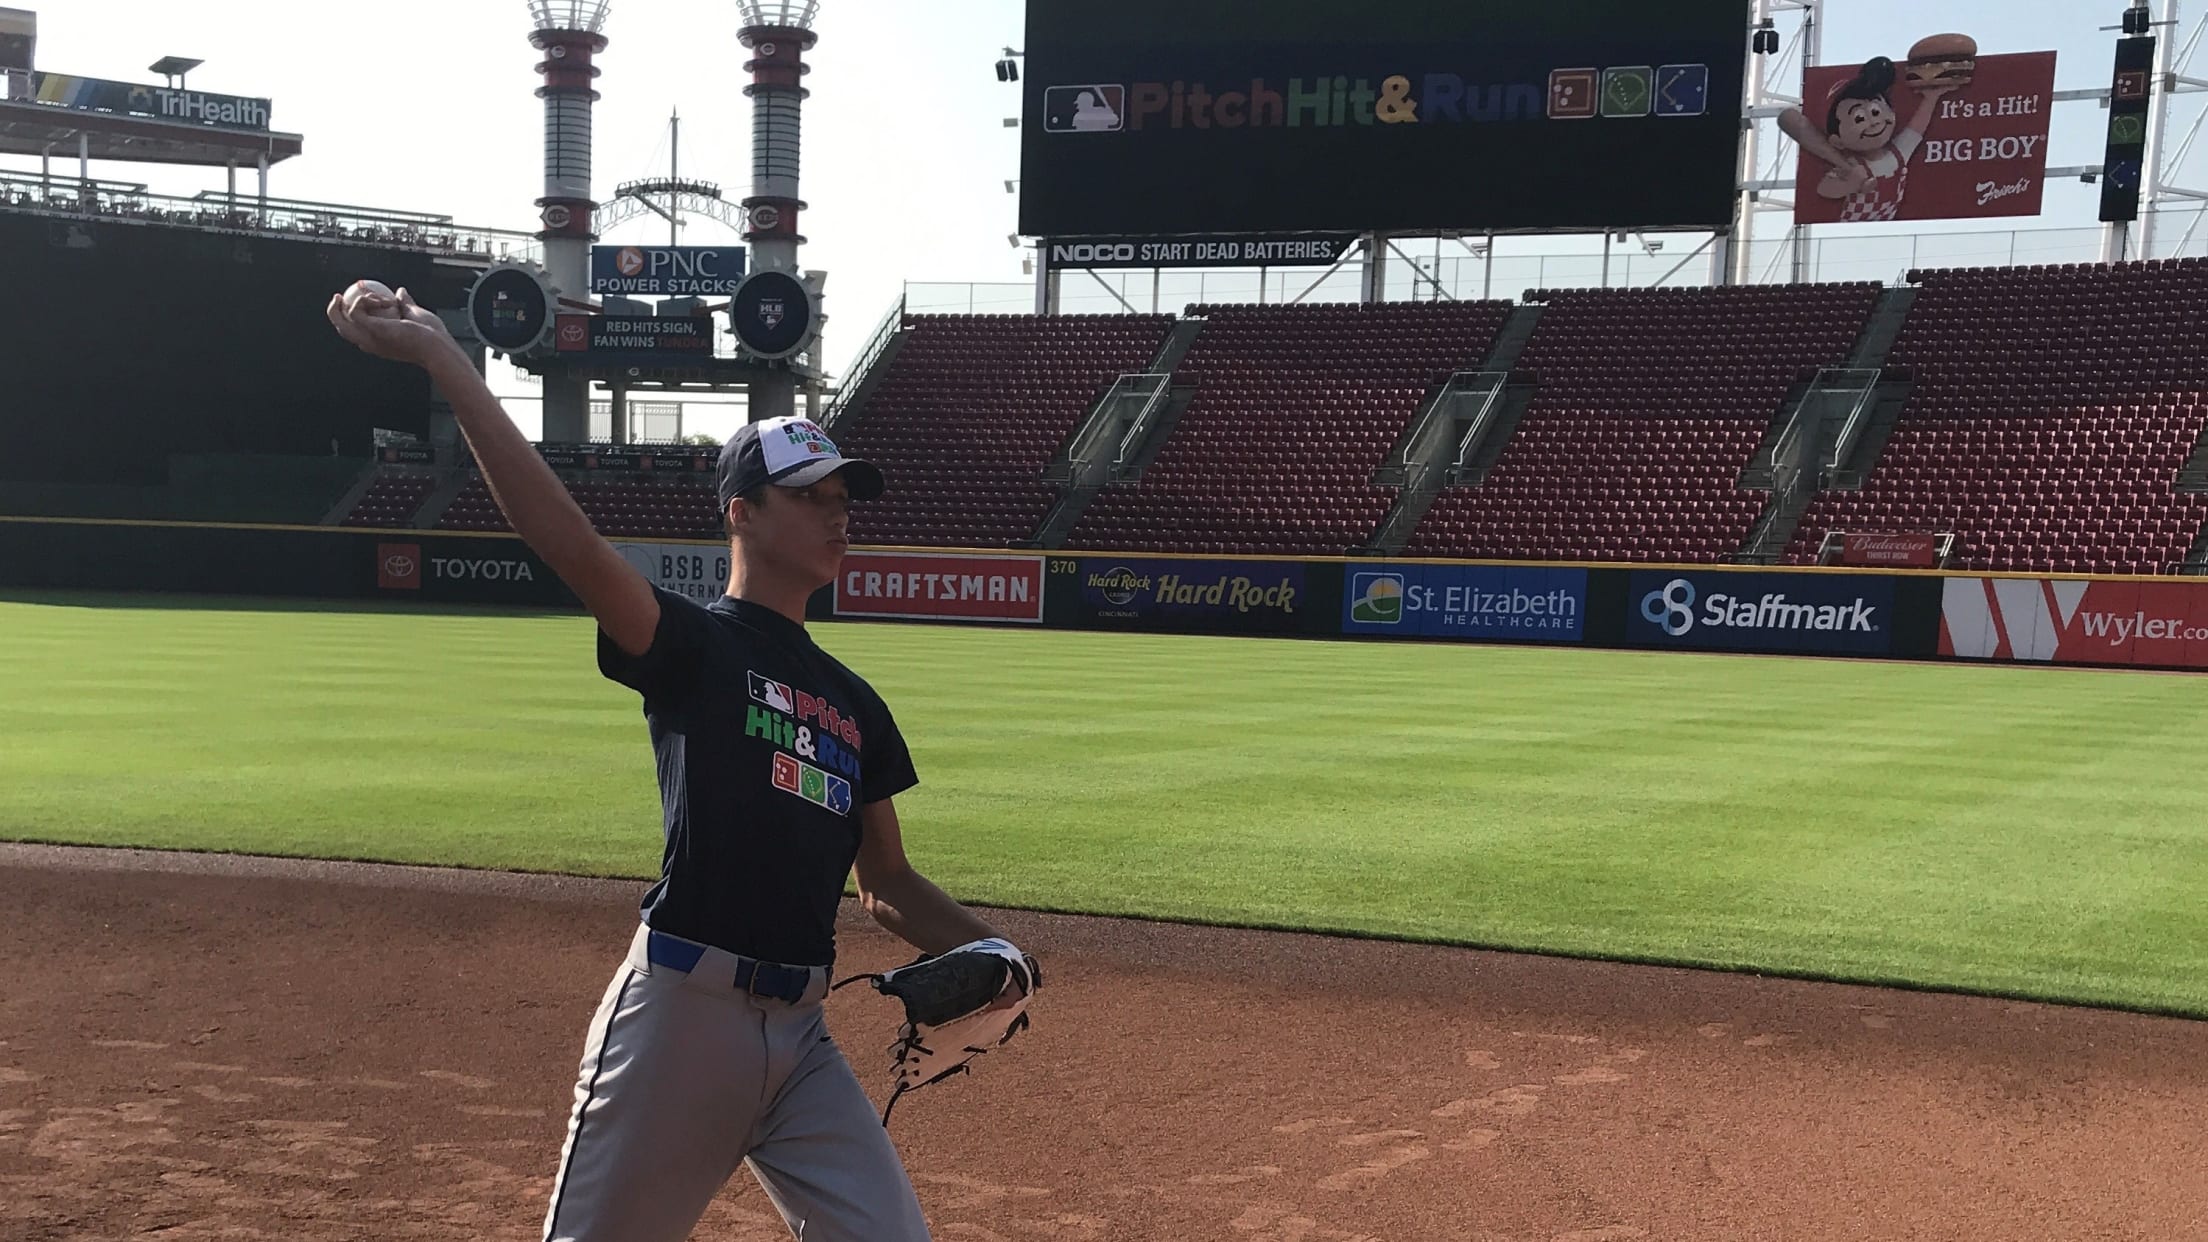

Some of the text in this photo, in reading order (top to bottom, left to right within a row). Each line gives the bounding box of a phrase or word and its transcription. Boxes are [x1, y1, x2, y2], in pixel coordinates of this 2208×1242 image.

[156, 89, 268, 126] TriHealth
[1422, 73, 1542, 124] Run
[1940, 94, 2039, 119] It's a Hit!
[1924, 135, 2039, 163] BIG BOY
[1975, 177, 2031, 206] Frisch's
[648, 250, 718, 277] PNC
[1053, 241, 1336, 262] NOCO START DEAD BATTERIES.
[597, 278, 737, 293] POWER STACKS
[606, 321, 697, 336] RED HITS SIGN,
[594, 335, 710, 349] FAN WINS TUNDRA
[1850, 536, 1927, 551] Budweiser
[431, 557, 534, 582] TOYOTA
[662, 555, 703, 581] BSB
[1050, 560, 1077, 575] 370
[846, 570, 1029, 603] CRAFTSMAN
[1087, 573, 1151, 591] Hard Rock
[1156, 574, 1296, 614] Hard Rock
[1406, 584, 1576, 617] St. Elizabeth
[1701, 591, 1876, 633] Staffmark
[1443, 614, 1575, 630] HEALTHCARE
[745, 704, 796, 750] Hit
[795, 725, 817, 762] &
[795, 688, 862, 753] Pitch
